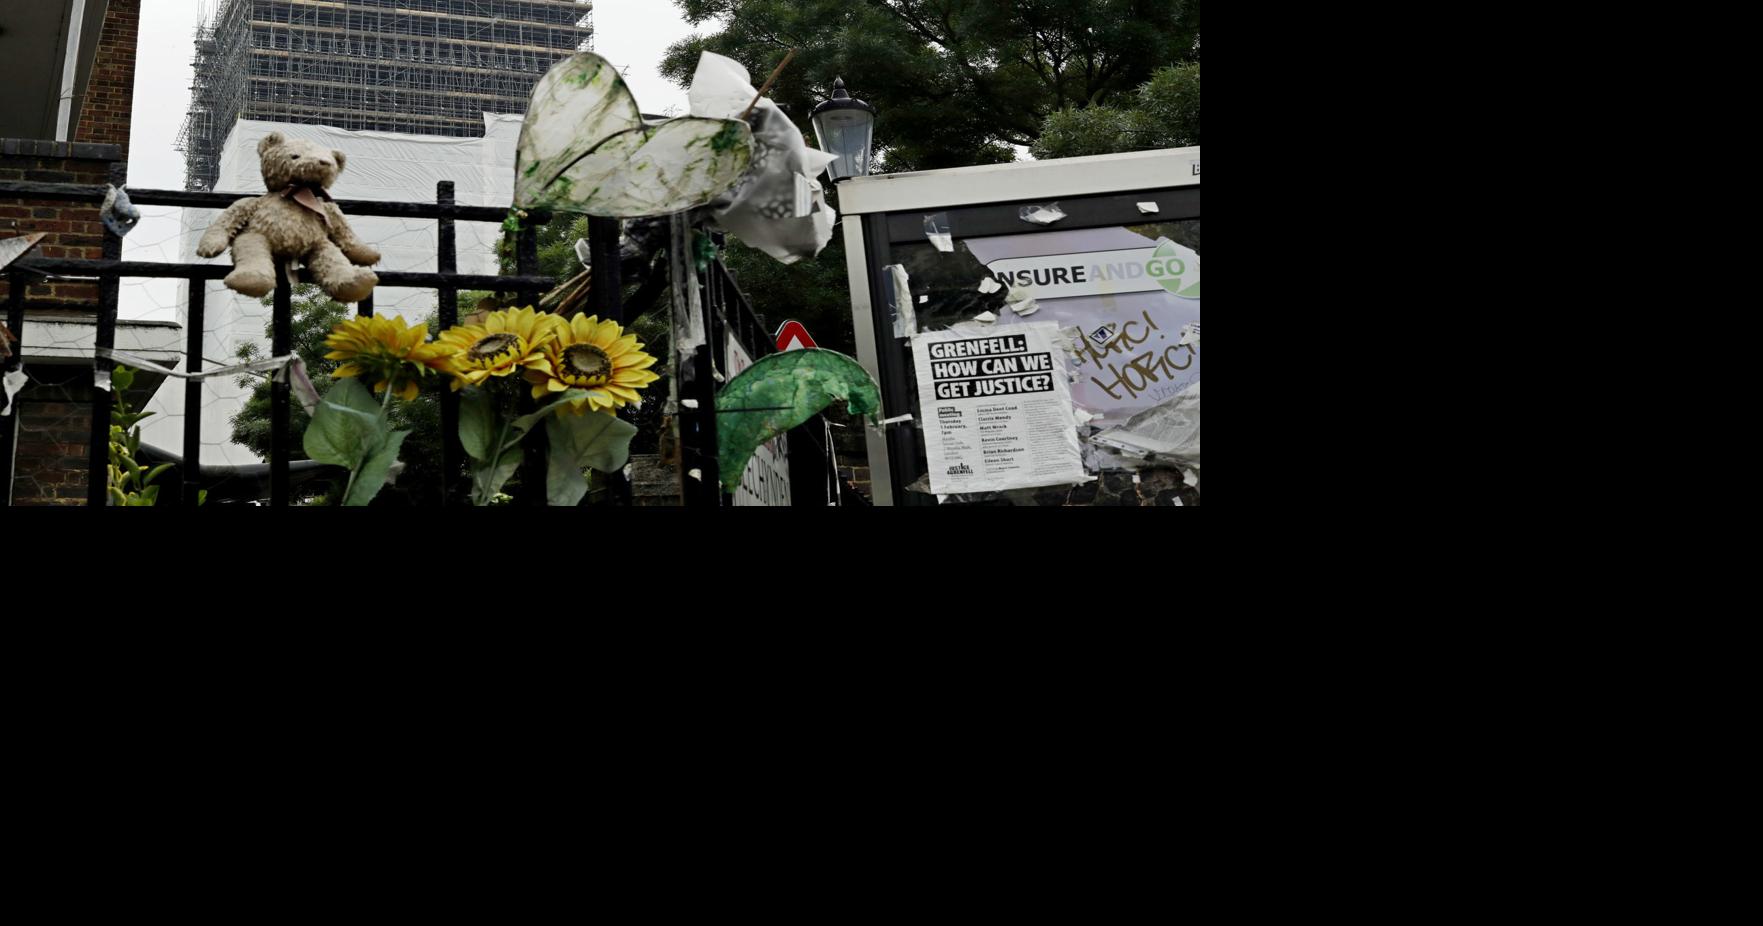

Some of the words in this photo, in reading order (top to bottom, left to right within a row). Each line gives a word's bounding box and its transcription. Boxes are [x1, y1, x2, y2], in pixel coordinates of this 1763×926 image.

[930, 337, 1025, 358] GRENFELL:
[934, 361, 978, 378] HOW
[981, 357, 1018, 375] CAN
[1020, 354, 1050, 371] WE
[937, 381, 970, 398] GET
[974, 374, 1050, 396] JUSTICE?
